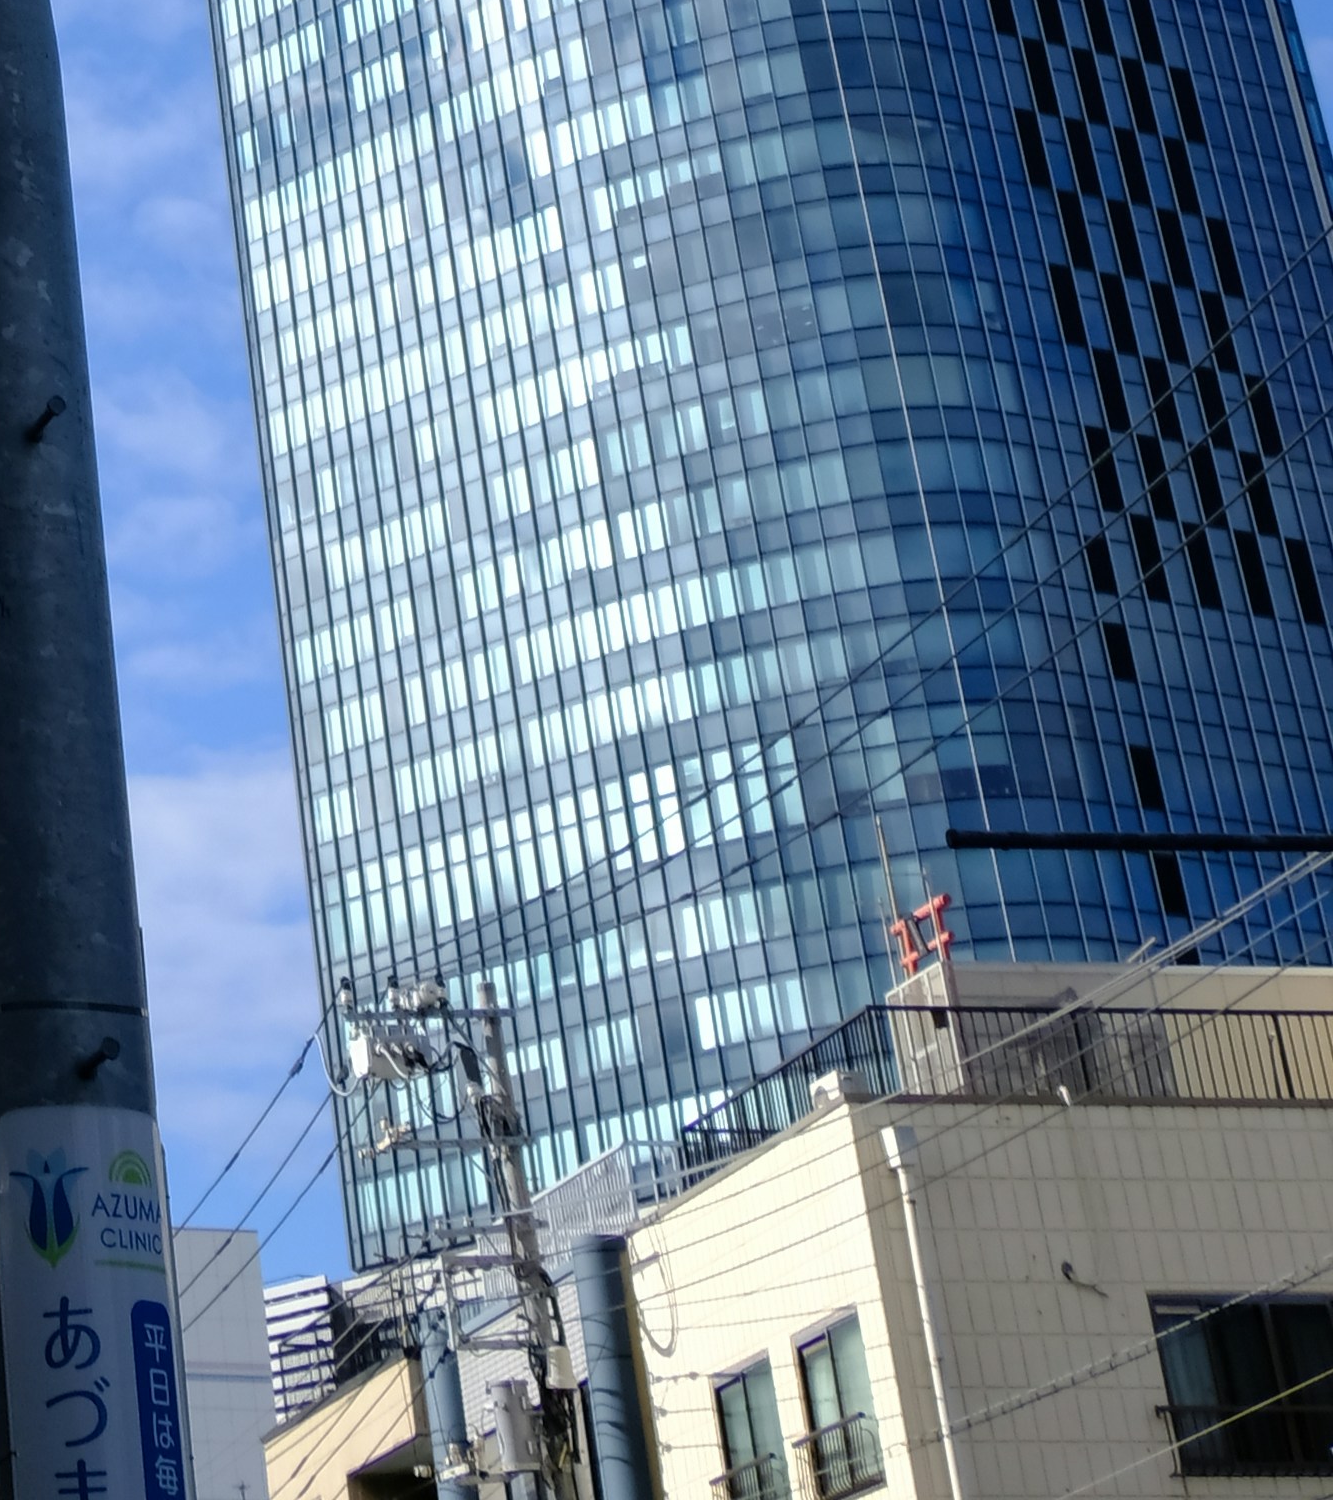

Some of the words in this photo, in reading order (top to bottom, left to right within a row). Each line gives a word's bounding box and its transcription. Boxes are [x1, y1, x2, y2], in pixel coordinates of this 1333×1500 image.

[100, 1227, 163, 1255] CLINIC
[144, 1323, 179, 1496] 平日は毎
